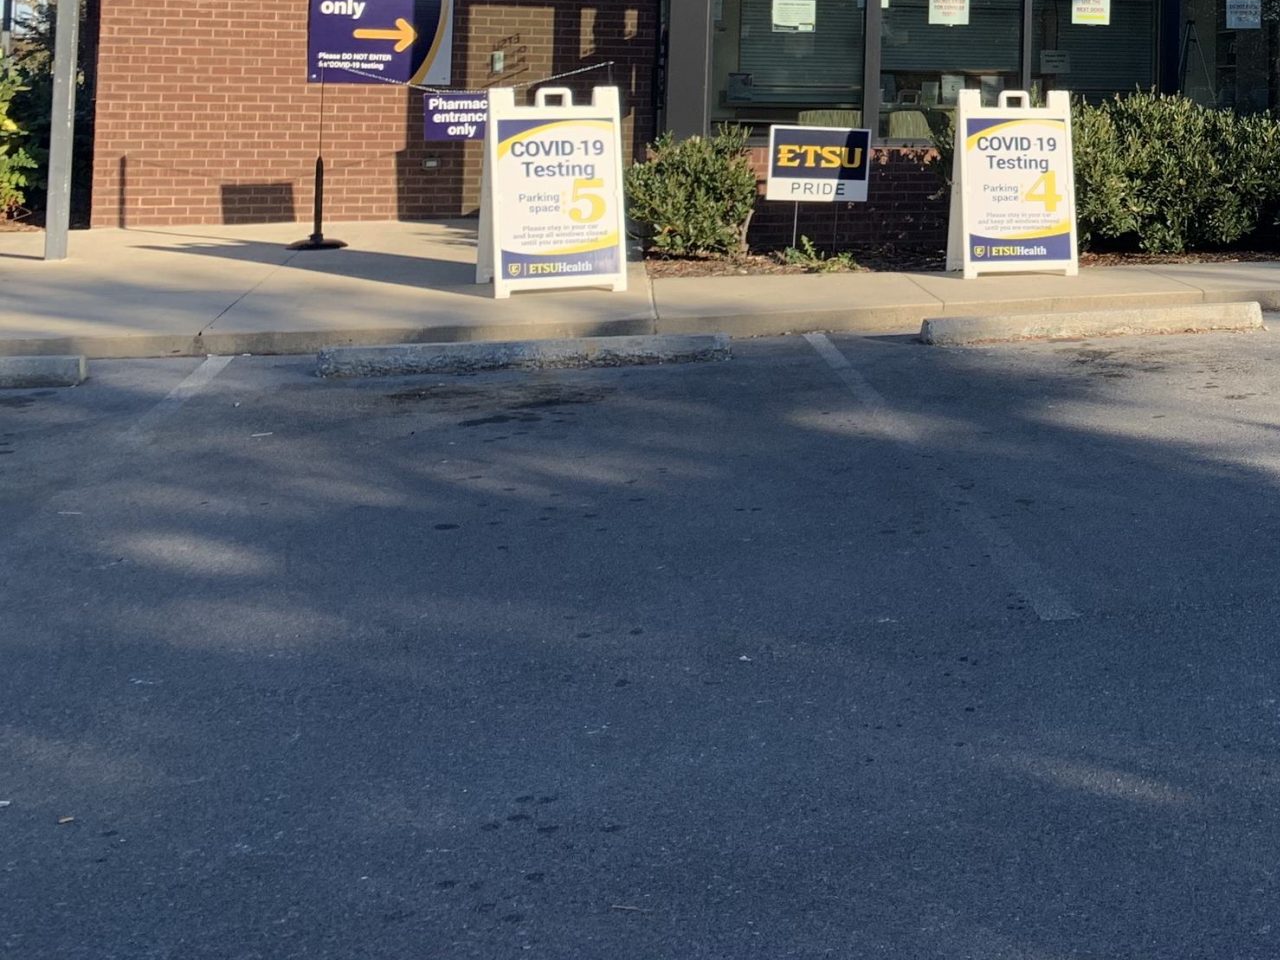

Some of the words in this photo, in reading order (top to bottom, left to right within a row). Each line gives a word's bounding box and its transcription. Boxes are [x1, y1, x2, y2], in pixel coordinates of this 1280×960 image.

[318, 52, 340, 60] Please
[361, 62, 384, 71] testing
[429, 98, 488, 110] Pharmac
[433, 112, 487, 123] entranc
[447, 124, 476, 137] only
[511, 140, 604, 157] COVID-19
[977, 136, 1056, 152] COVID-19
[777, 144, 862, 168] ETSU
[522, 160, 595, 179] Testing
[986, 154, 1049, 173] Testing
[791, 182, 845, 196] PRIDE
[984, 184, 1019, 193] Parking
[1024, 170, 1062, 212] 4
[519, 193, 560, 205] Parking
[569, 178, 606, 223] 5
[992, 194, 1019, 203] space
[529, 204, 560, 215] space
[992, 246, 1046, 256] ETSUHealth
[529, 261, 592, 274] ETSUHealth
